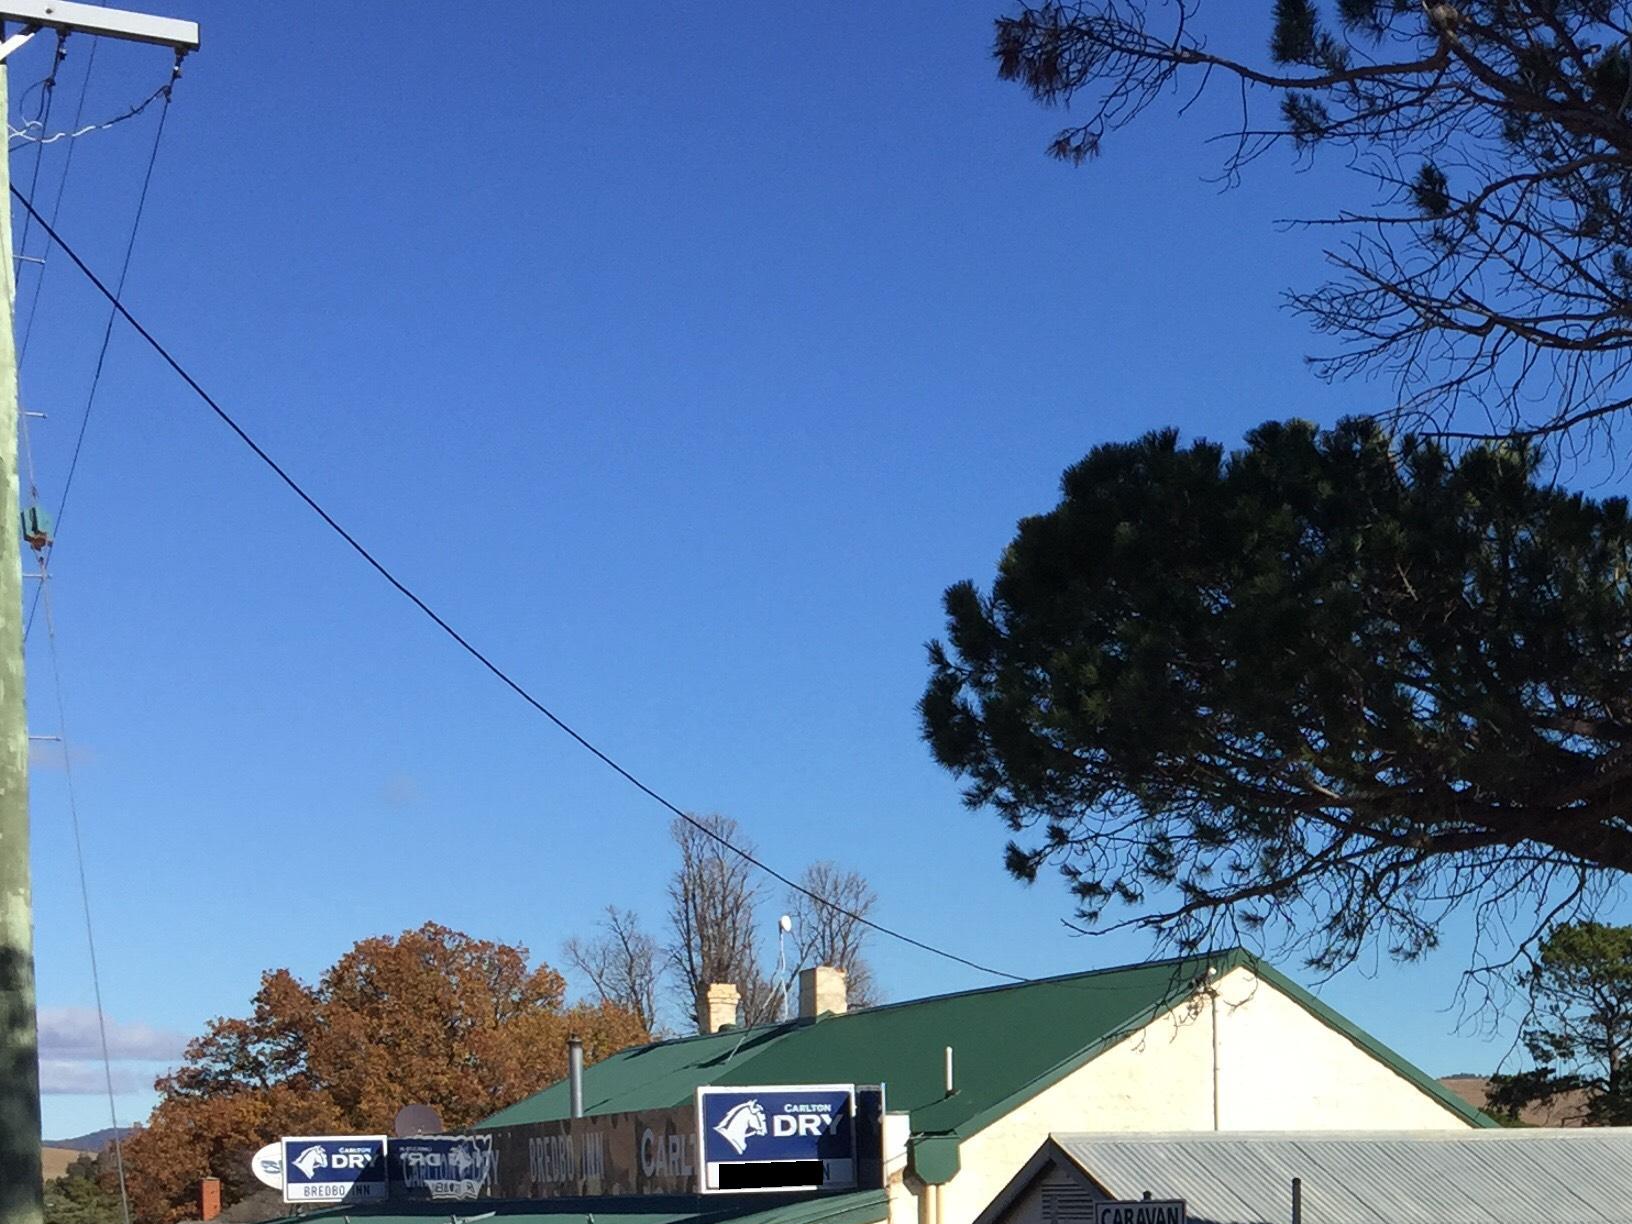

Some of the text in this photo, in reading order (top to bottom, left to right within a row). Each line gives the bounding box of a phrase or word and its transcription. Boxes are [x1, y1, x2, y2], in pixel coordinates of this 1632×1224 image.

[784, 1103, 832, 1113] CARLTON
[773, 1114, 843, 1137] DRY
[331, 1153, 380, 1169] DRY
[528, 1135, 575, 1184] BREDBO
[303, 1184, 370, 1197] BREDBO INN
